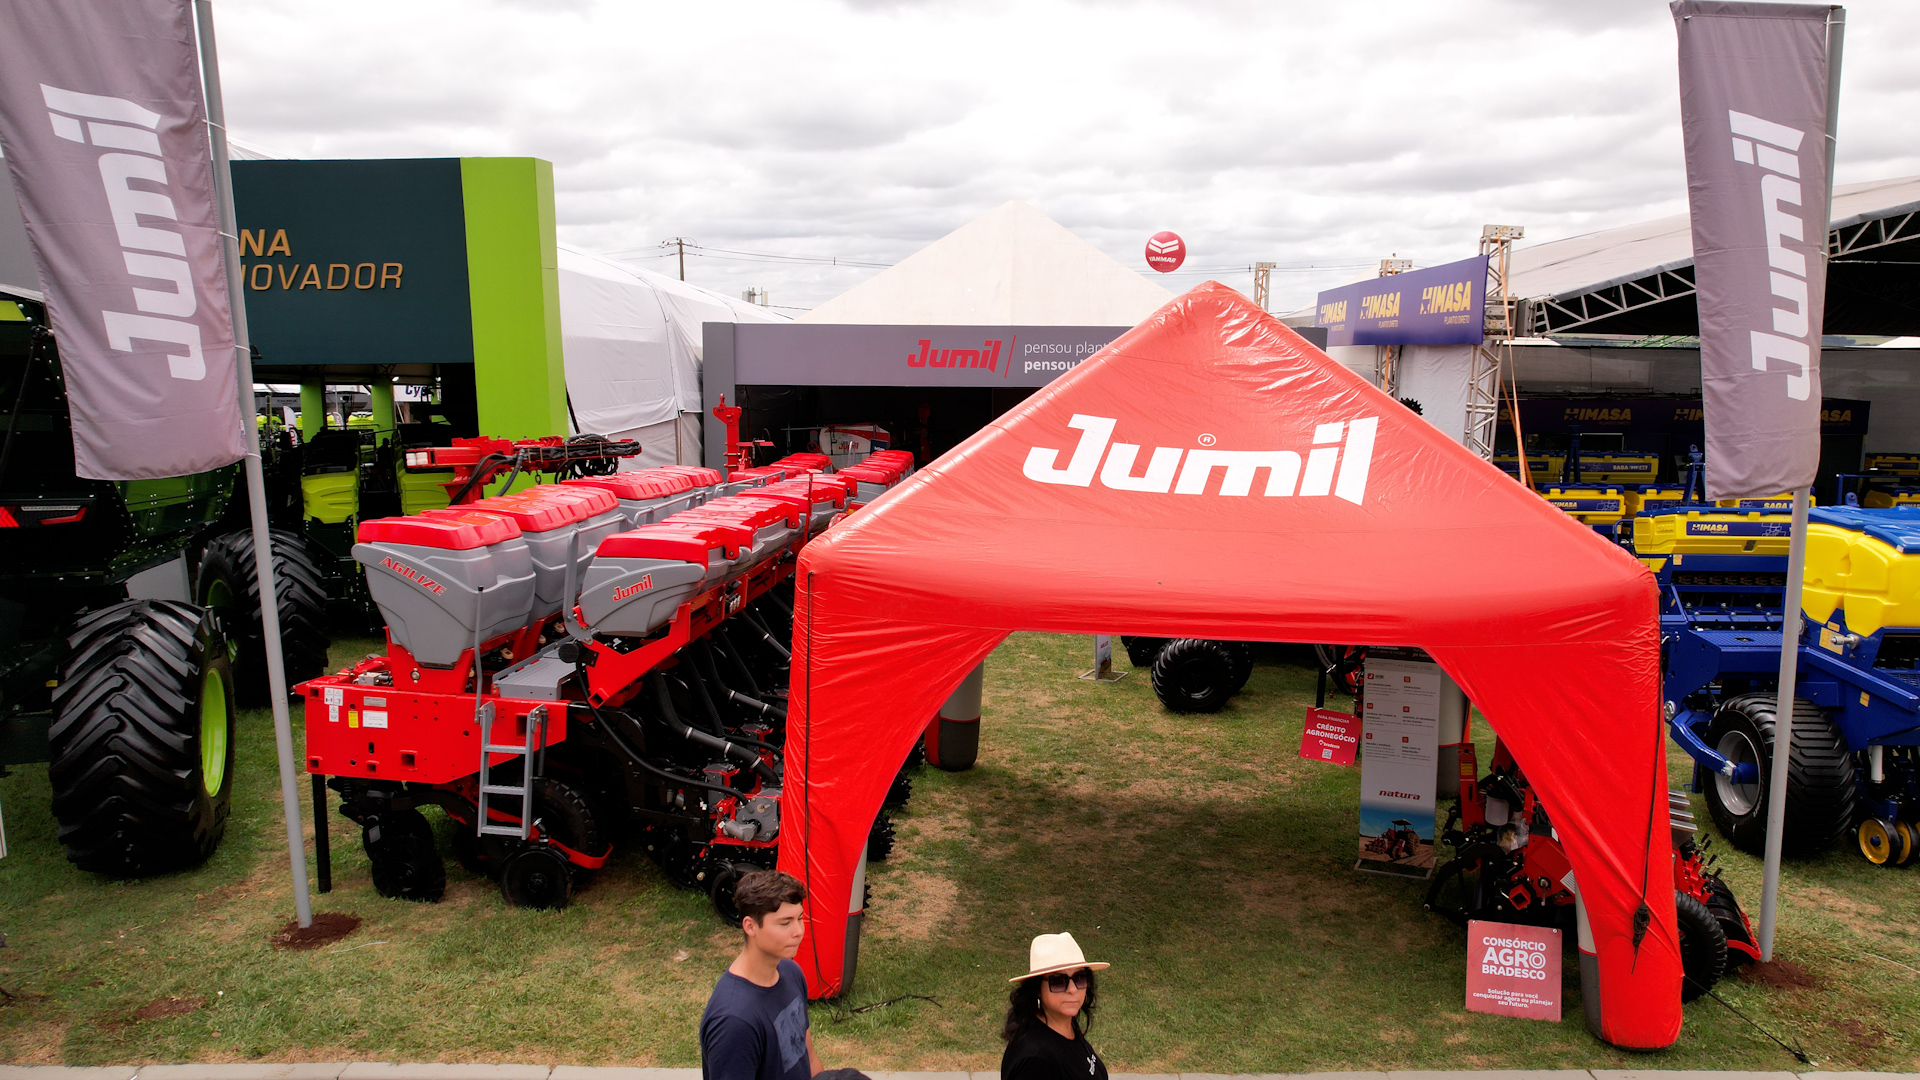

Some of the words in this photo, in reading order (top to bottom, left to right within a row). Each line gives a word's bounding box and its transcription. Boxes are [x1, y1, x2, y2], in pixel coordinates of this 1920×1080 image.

[40, 83, 207, 381] Jumil
[1149, 255, 1177, 263] YANMAR
[1729, 109, 1805, 402] Jumil
[1360, 291, 1401, 320] HIMASA
[1420, 280, 1472, 315] HIMASA
[1319, 300, 1347, 325] HIMASA
[907, 339, 1002, 374] Jumil
[1024, 343, 1073, 357] pensou
[1024, 360, 1076, 374] pensou
[1563, 408, 1632, 421] HIMASA
[1022, 413, 1379, 506] Jumil
[1691, 523, 1729, 532] HIMASA
[379, 556, 447, 597] AGILIZE
[612, 574, 654, 602] Jumil
[1306, 728, 1356, 743] AGRONEGÓCIO
[1316, 722, 1347, 734] CRÉDITO
[1379, 790, 1421, 801] natura
[1482, 936, 1547, 952] CONSÓRCIO
[1482, 946, 1546, 969] AGRO
[1481, 964, 1546, 981] BRADESCO
[1472, 992, 1503, 1001] conquistar
[1504, 995, 1520, 1003] agora
[1530, 998, 1554, 1007] planejar
[1487, 988, 1510, 997] Solução
[1525, 992, 1539, 1000] você
[1509, 1000, 1529, 1009] futuro.
